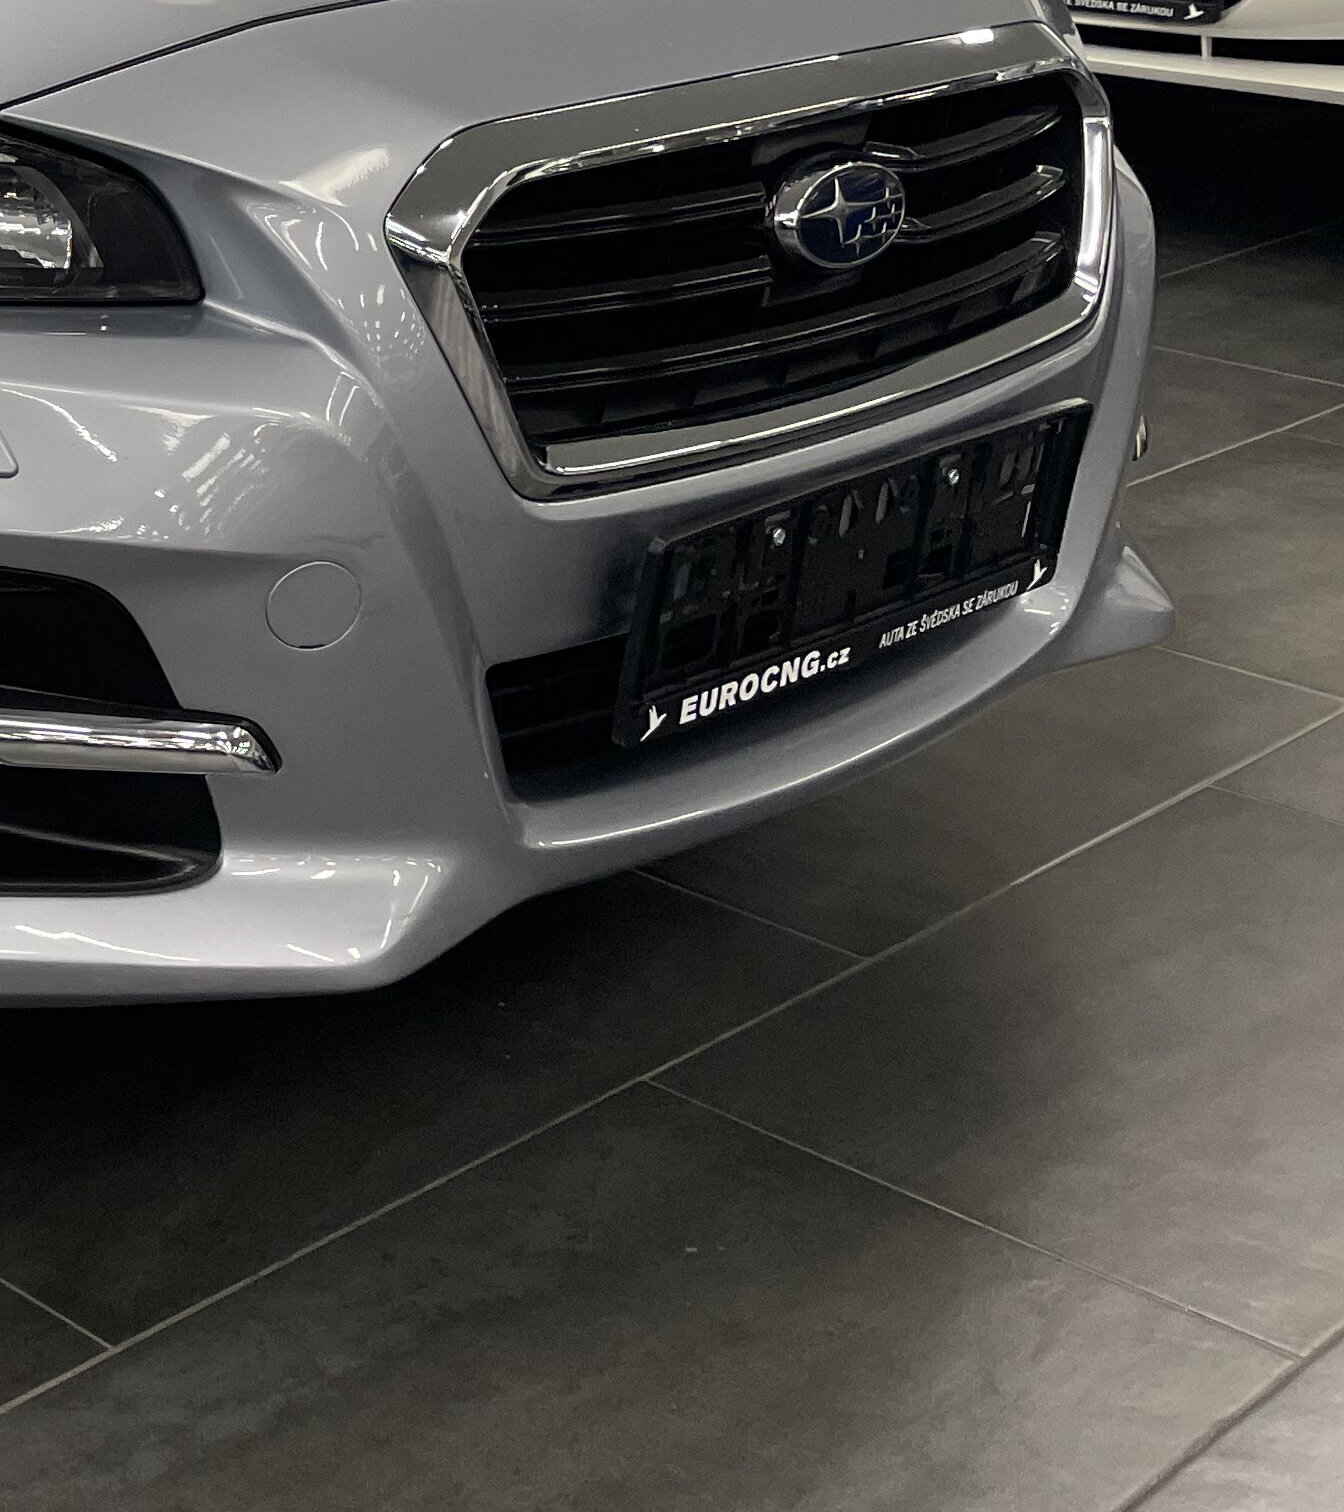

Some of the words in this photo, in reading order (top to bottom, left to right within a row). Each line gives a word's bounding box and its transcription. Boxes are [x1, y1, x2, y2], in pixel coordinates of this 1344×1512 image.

[878, 625, 905, 650] AUTA
[905, 619, 920, 639] ZE
[919, 602, 961, 633] ŠVÉDSKA
[961, 597, 976, 616] SE
[975, 579, 1019, 611] ZÁRUKOU
[678, 646, 852, 725] EUROCNG.cz
